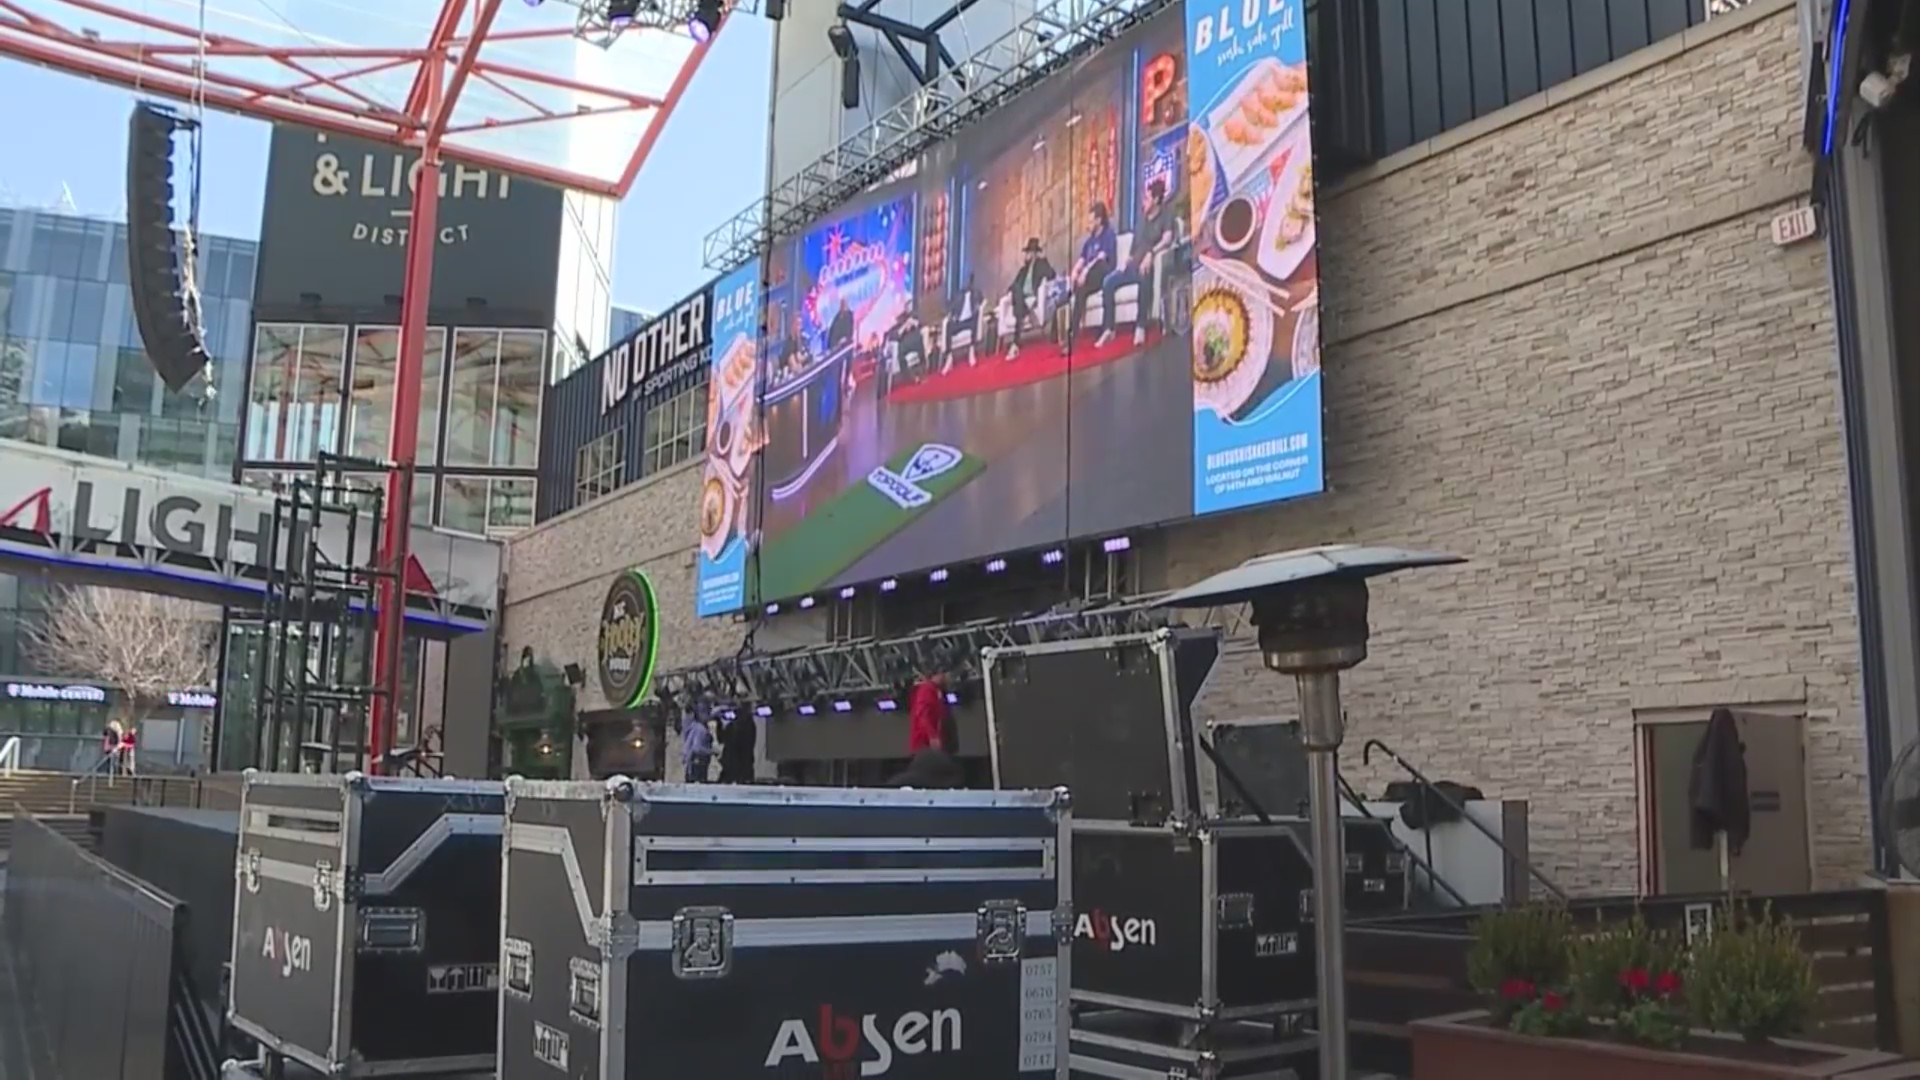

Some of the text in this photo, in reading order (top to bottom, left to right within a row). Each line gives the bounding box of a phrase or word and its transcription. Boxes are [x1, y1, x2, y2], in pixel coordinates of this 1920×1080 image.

[312, 152, 350, 195] &
[352, 223, 470, 247] DISTCT
[1779, 210, 1808, 240] EXIT
[715, 281, 754, 323] BLUE
[601, 293, 705, 416] NO OTHER
[644, 352, 698, 396] SPORTING
[1205, 455, 1309, 486] LOCATED ON THE CORNER
[1213, 484, 1225, 495] OF
[1246, 476, 1264, 487] AND
[1265, 468, 1300, 484] WALNUT
